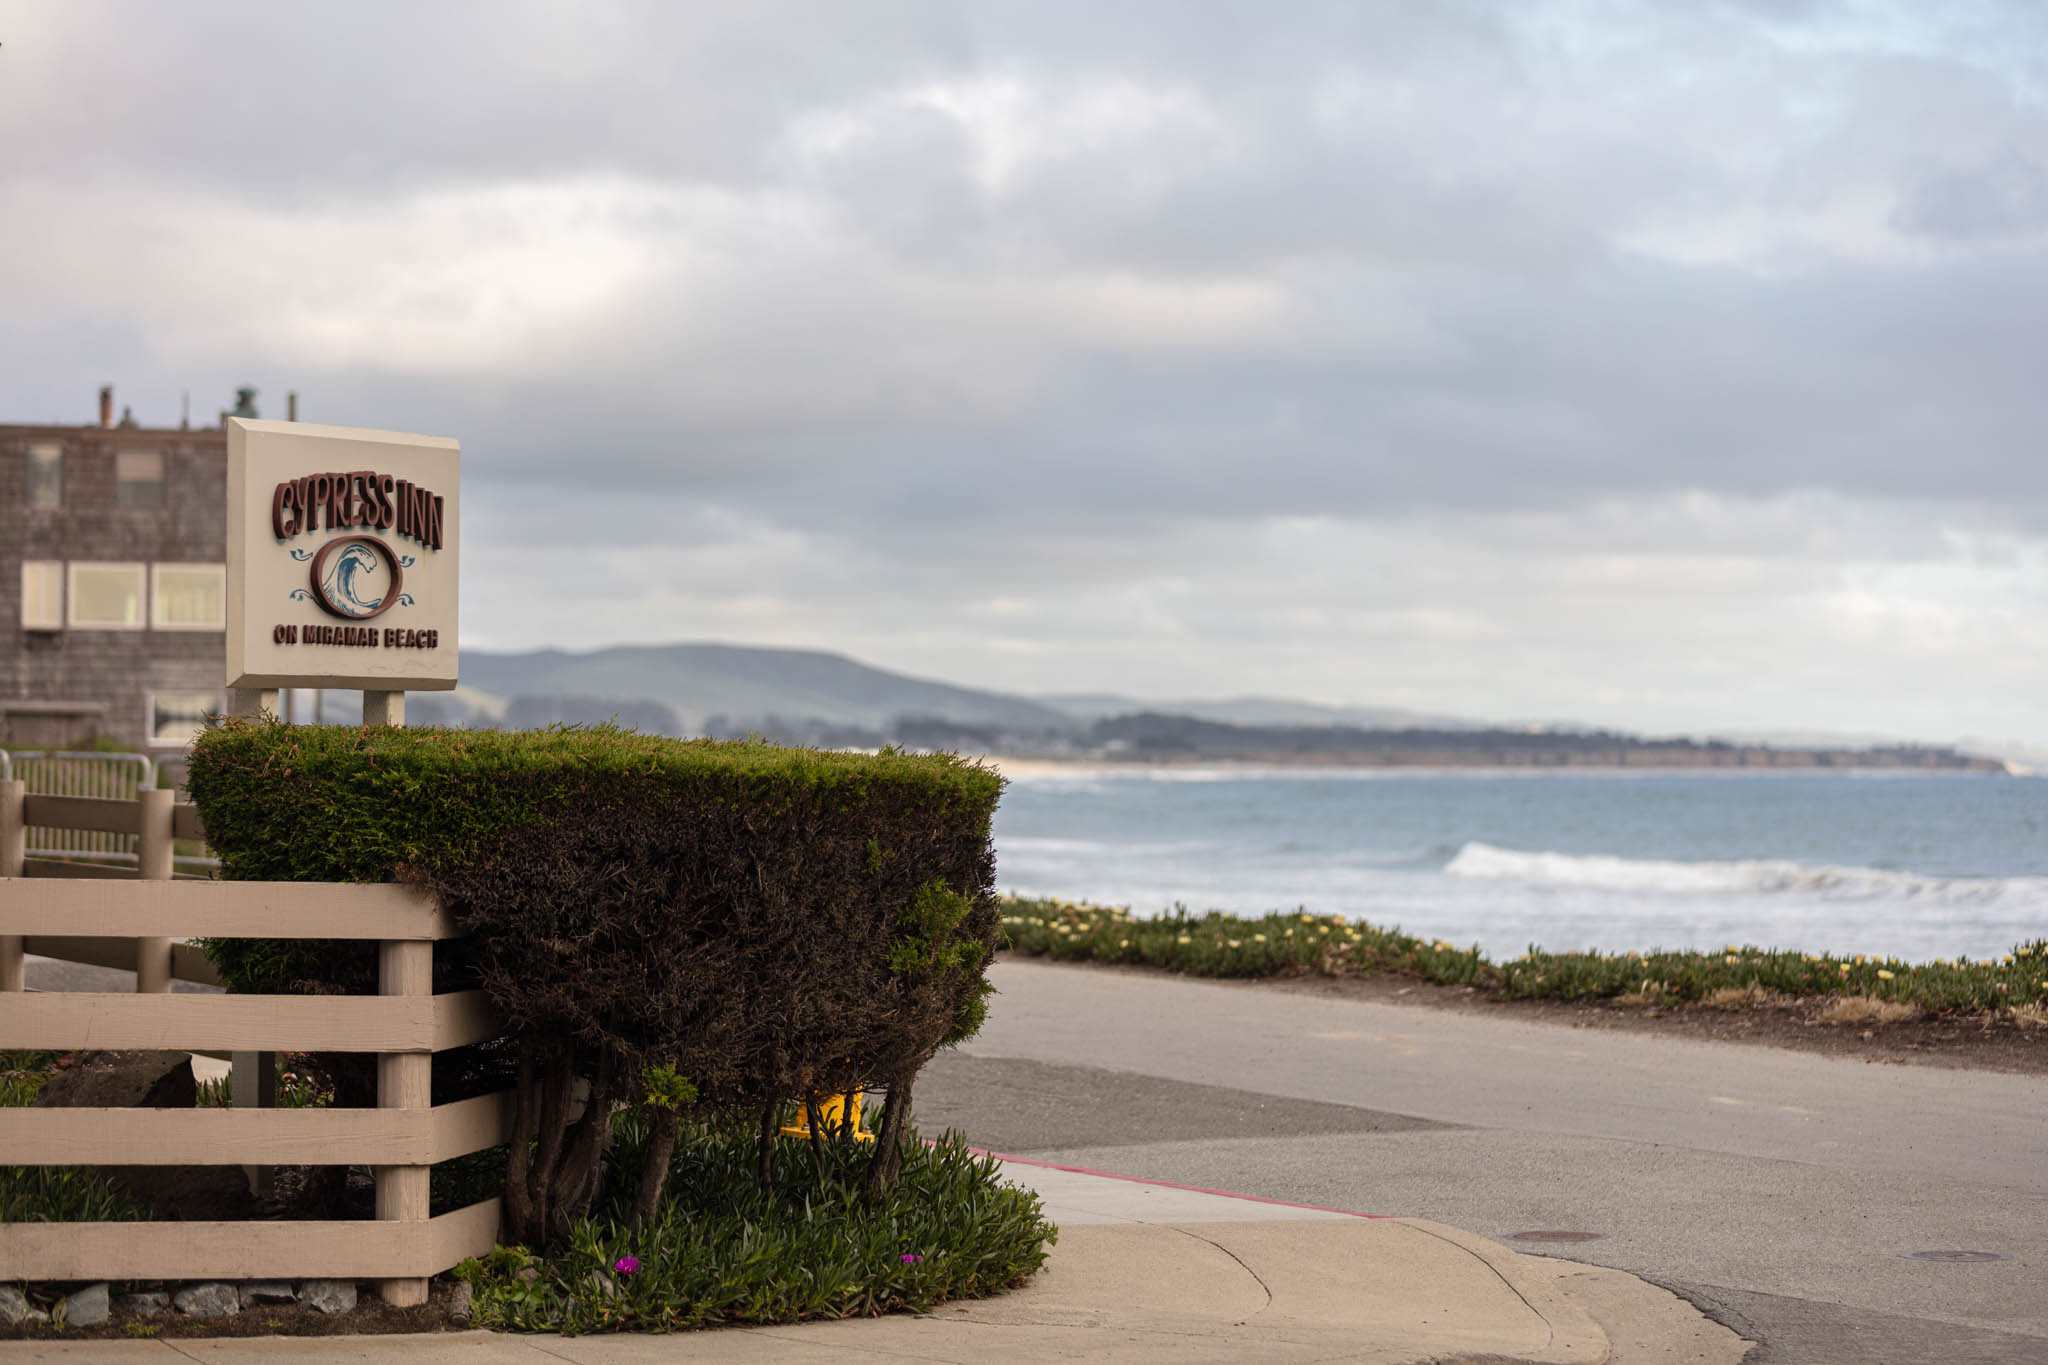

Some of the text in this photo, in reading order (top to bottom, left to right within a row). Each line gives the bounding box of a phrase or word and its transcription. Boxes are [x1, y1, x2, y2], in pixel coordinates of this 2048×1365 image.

[272, 471, 444, 550] CYPRESS INN
[274, 624, 438, 648] ON MIRAMAR BEACH
